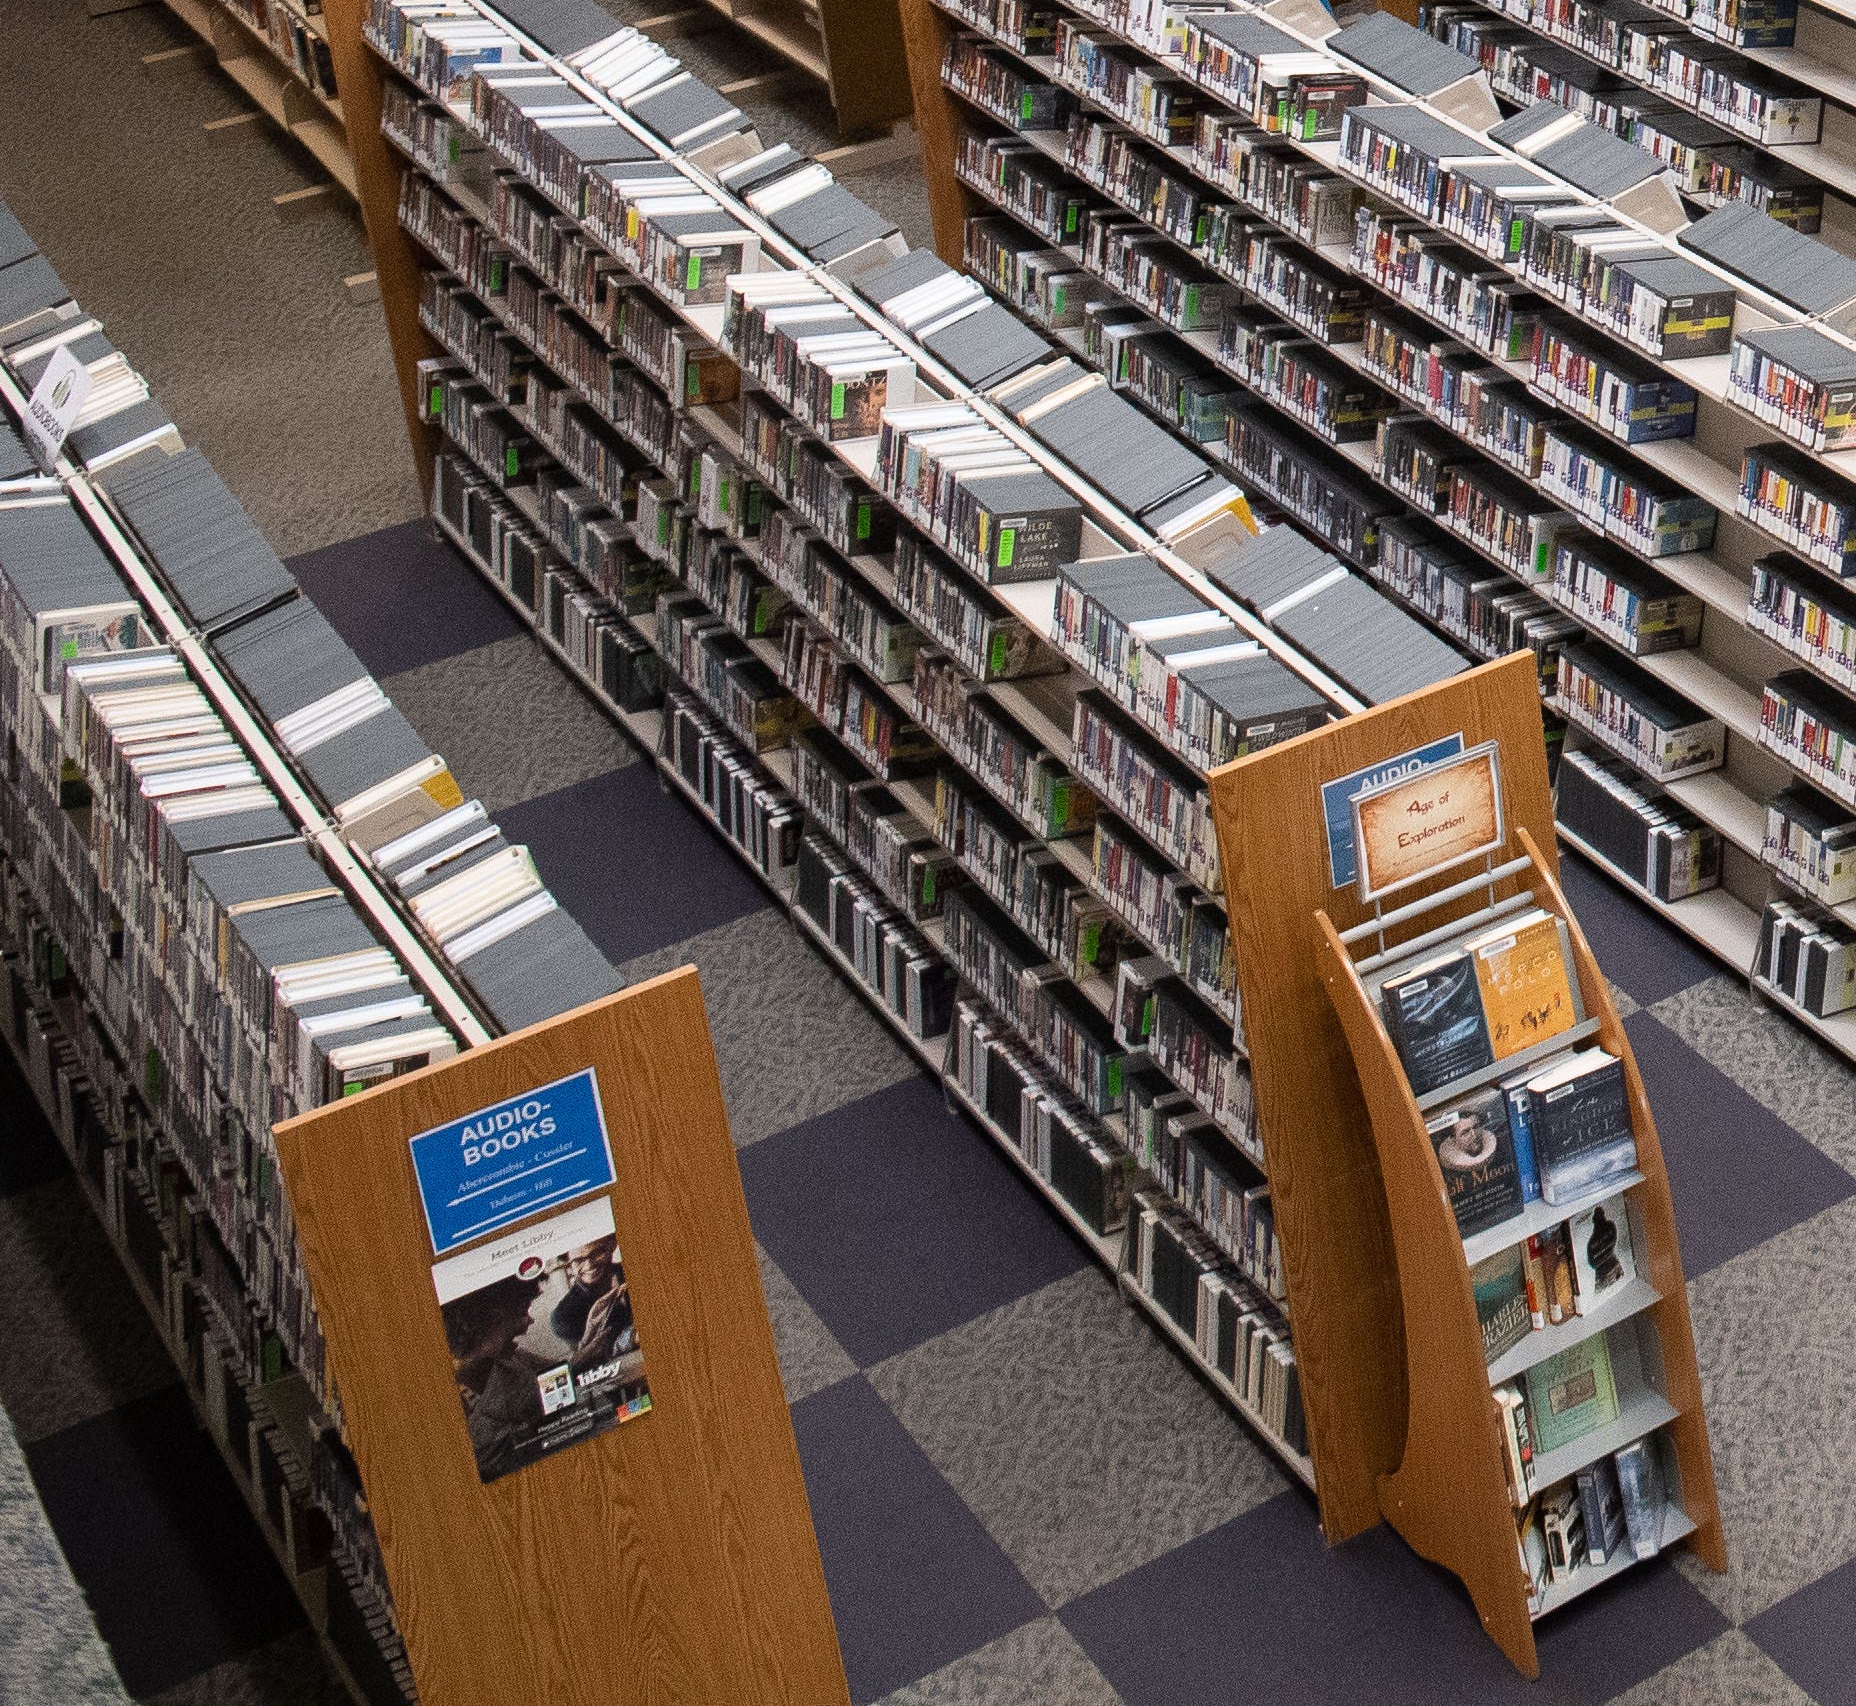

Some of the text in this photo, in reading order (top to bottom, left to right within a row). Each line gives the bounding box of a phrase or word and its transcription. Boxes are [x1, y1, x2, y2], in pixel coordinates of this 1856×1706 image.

[1406, 790, 1450, 817] Age of
[1397, 815, 1466, 850] Exploration
[460, 1100, 551, 1146] AUDIO-
[1584, 1116, 1618, 1139] ICE
[462, 1116, 557, 1167] BOOKS
[457, 1141, 573, 1193] Abercrombie Cussler
[1470, 1162, 1515, 1185] Moon
[490, 1241, 520, 1261] Meet
[576, 1359, 621, 1388] libby
